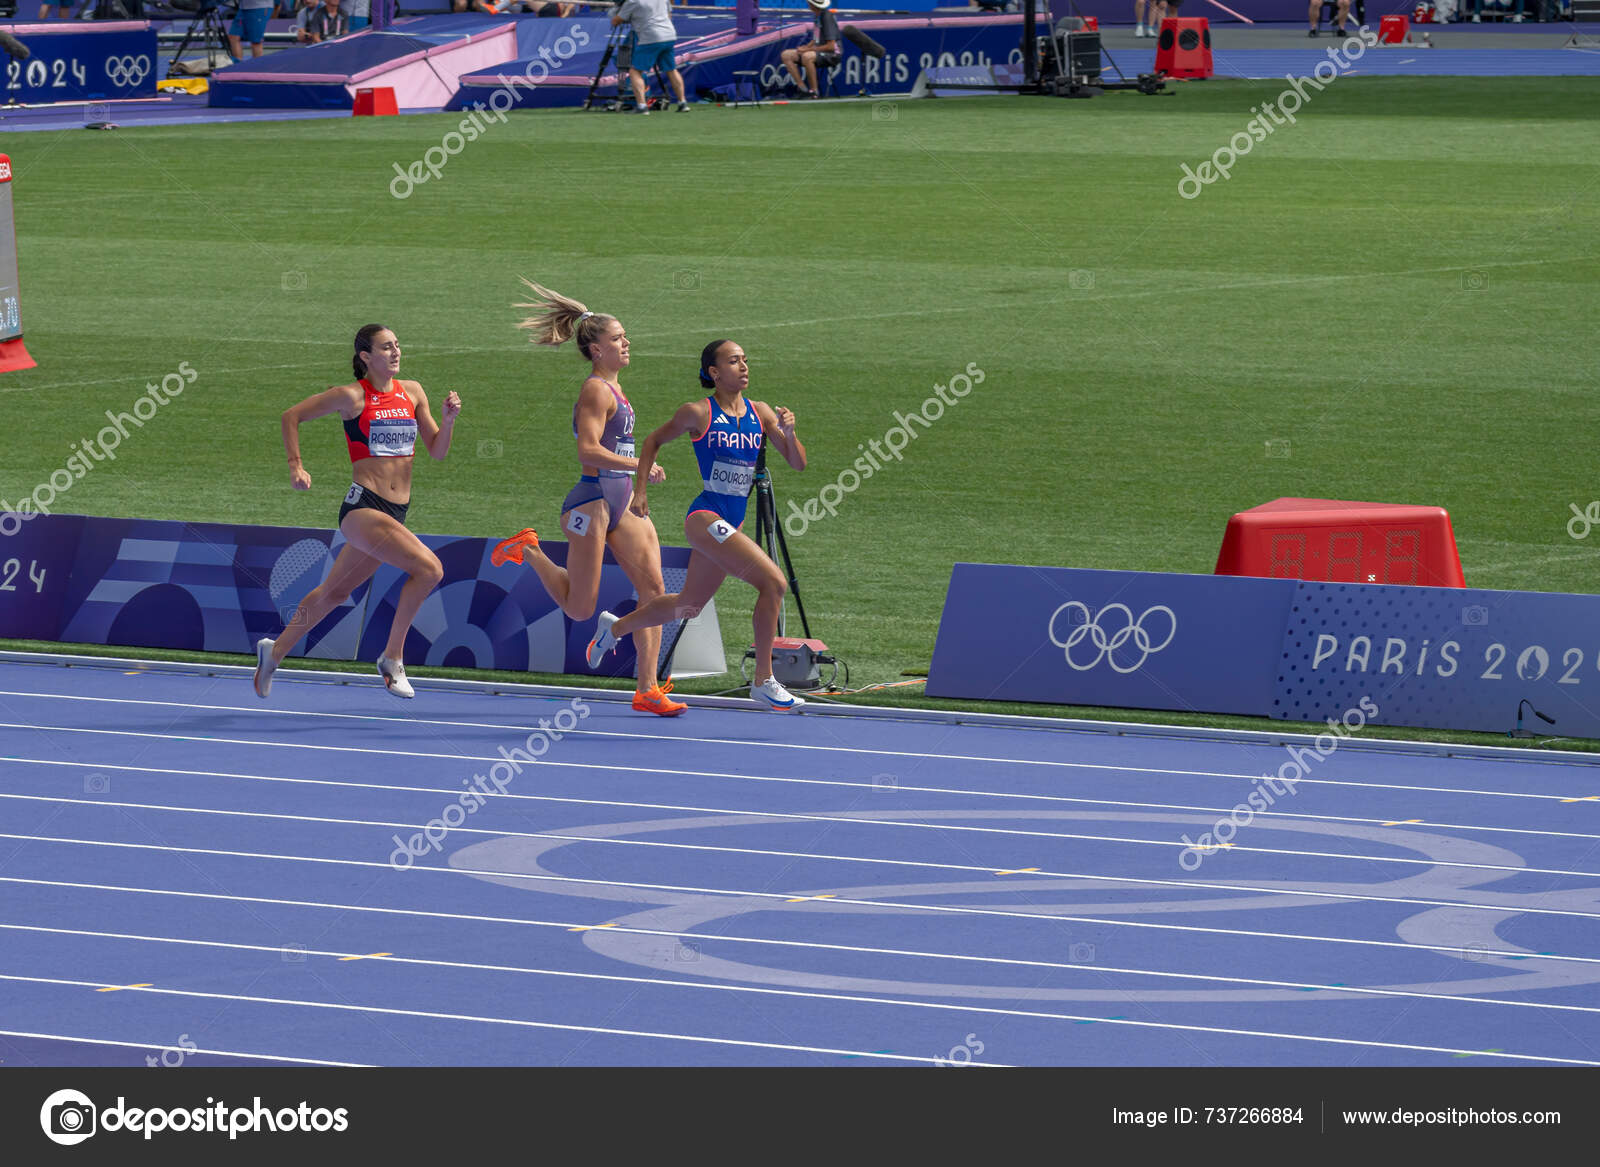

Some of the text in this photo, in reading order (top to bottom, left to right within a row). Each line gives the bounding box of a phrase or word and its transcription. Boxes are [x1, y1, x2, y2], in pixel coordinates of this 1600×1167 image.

[348, 487, 356, 499] 3
[573, 516, 584, 530] 2
[717, 524, 729, 536] 6
